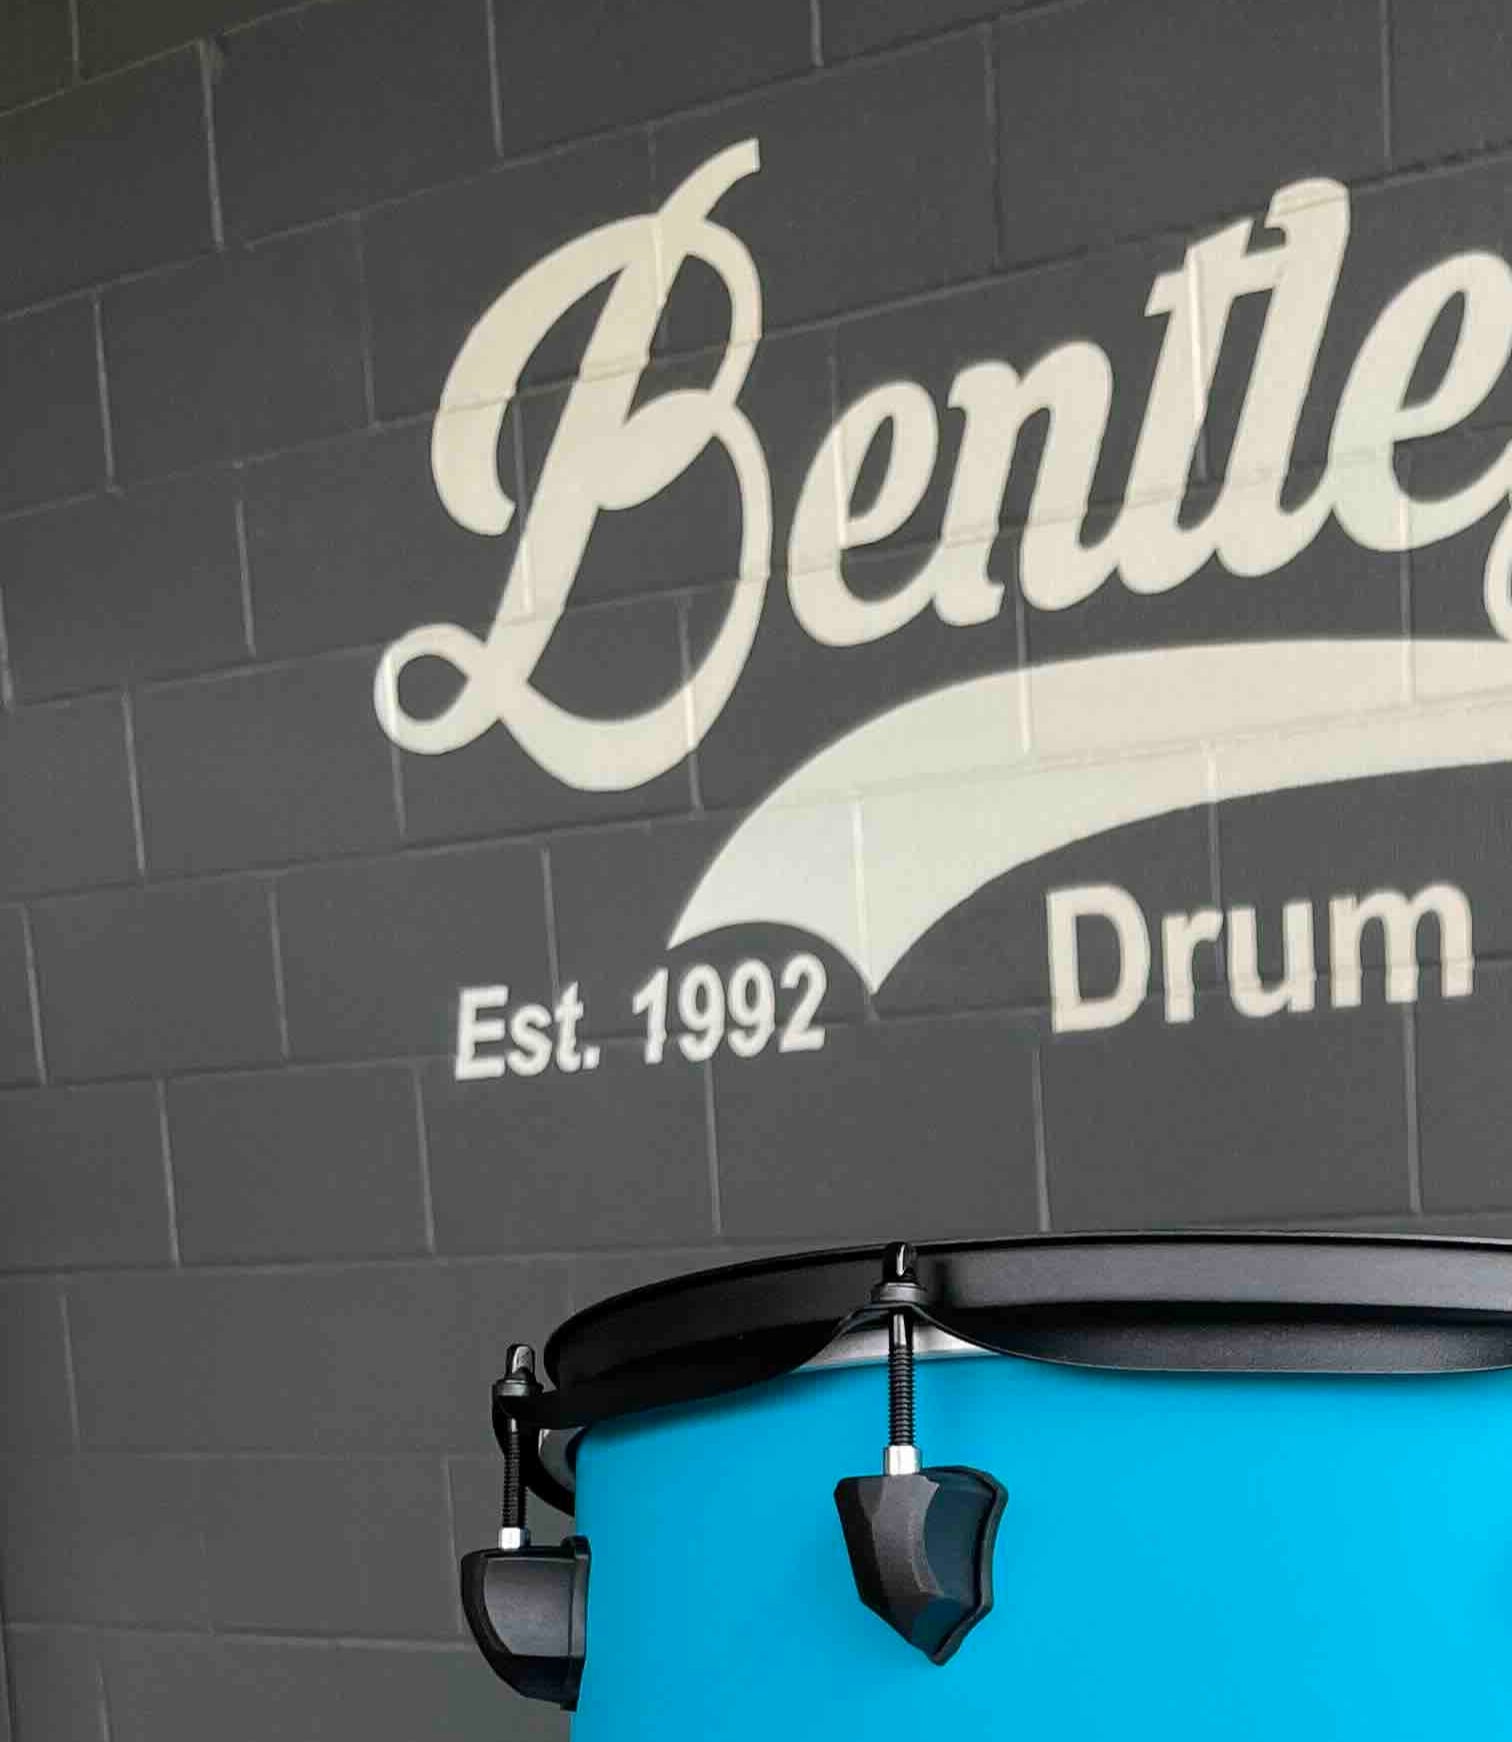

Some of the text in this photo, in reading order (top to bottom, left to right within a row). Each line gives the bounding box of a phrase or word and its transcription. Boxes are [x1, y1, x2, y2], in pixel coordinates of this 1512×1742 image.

[455, 954, 827, 1080] Est. 1992
[1047, 885, 1474, 1033] Drum
